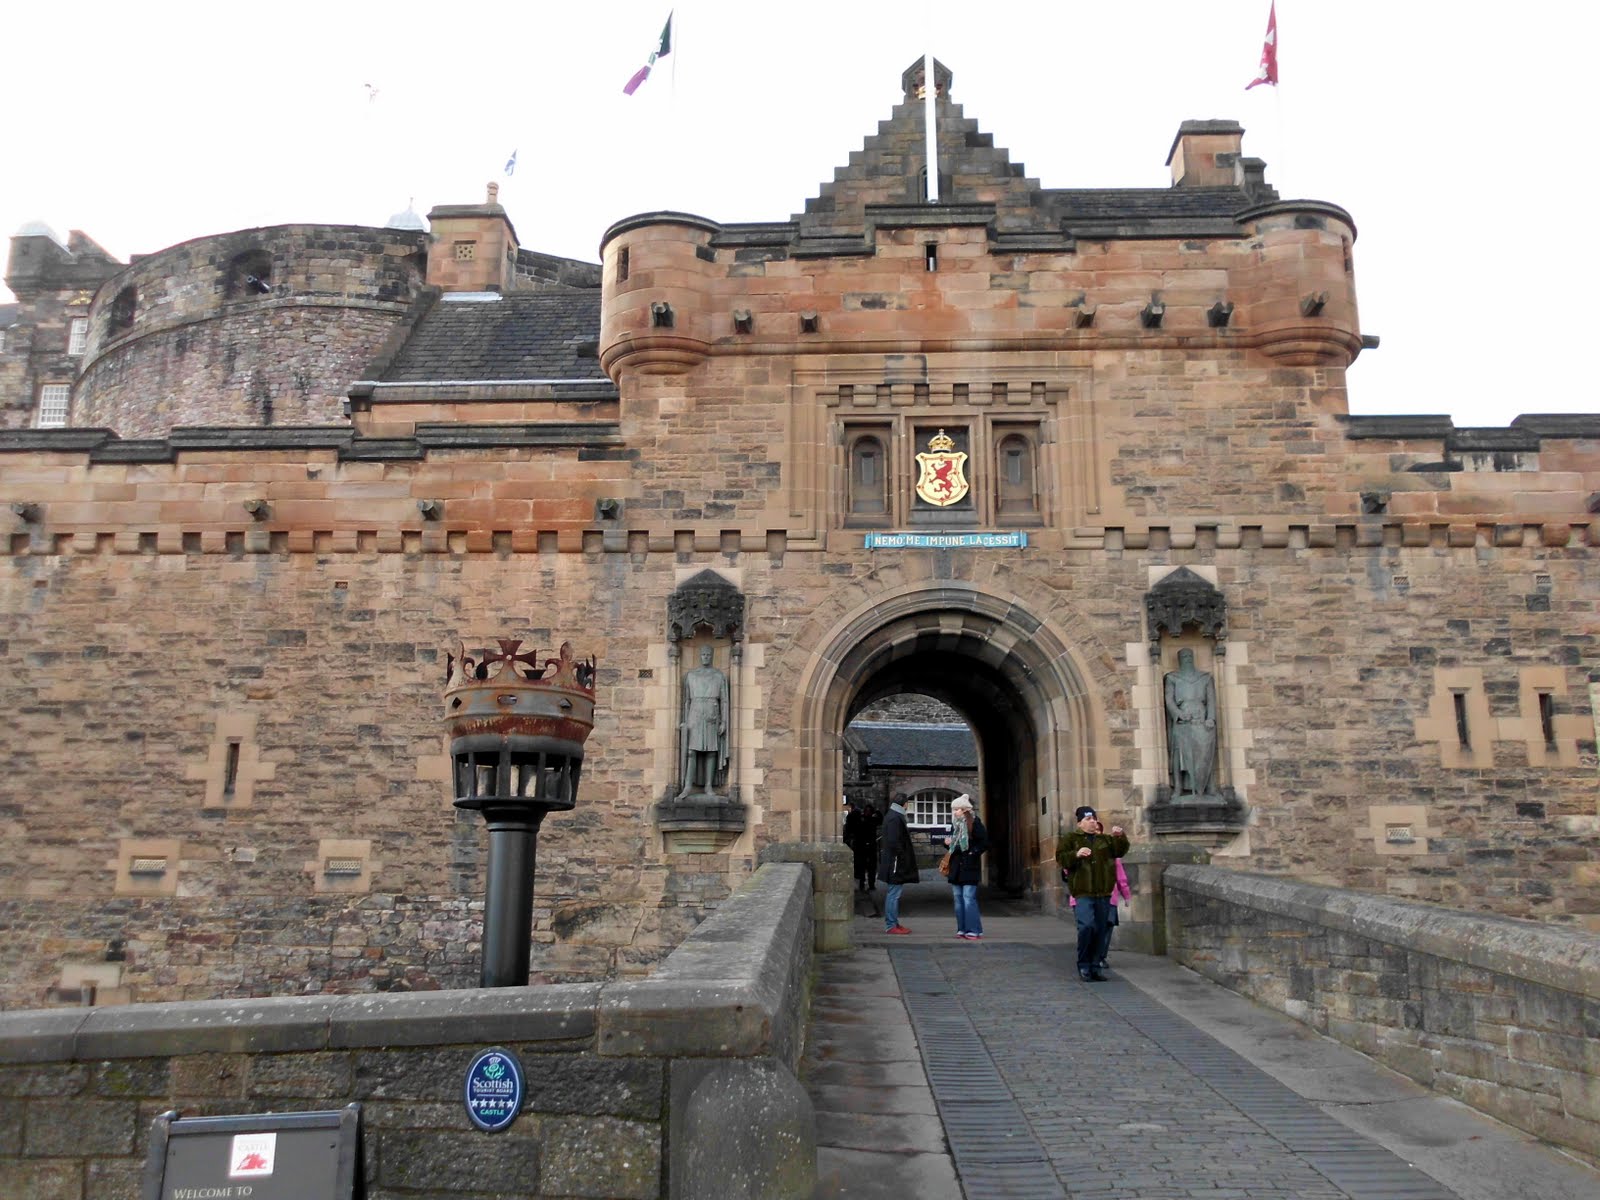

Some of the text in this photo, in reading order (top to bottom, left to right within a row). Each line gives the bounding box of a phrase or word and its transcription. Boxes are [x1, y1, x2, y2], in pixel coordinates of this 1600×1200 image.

[875, 535, 1019, 546] NEMO ME IMPUNE LACESSIT
[473, 1077, 514, 1088] Scottish
[174, 1185, 253, 1199] WELCOME TO
